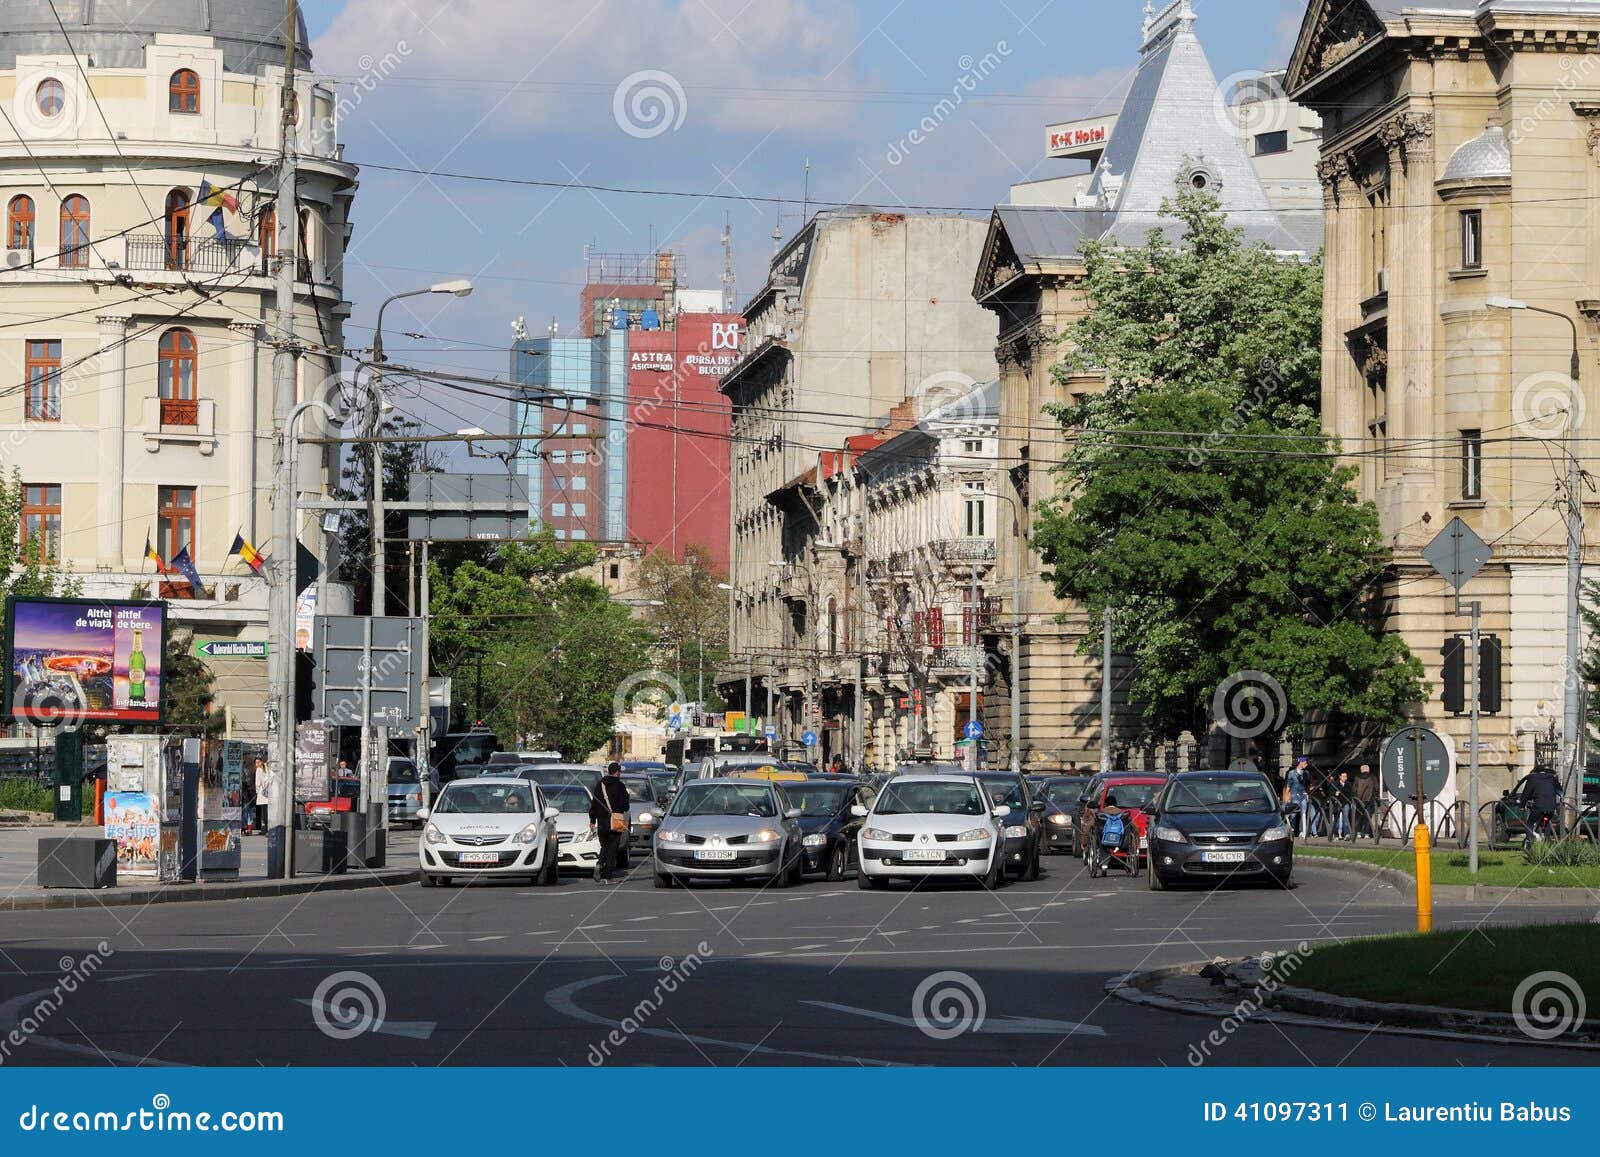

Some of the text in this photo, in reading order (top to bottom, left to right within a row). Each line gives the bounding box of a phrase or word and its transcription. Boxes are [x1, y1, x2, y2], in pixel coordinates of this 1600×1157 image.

[1051, 126, 1105, 148] K+K Hotel
[632, 353, 673, 362] ASTRA
[686, 355, 716, 365] BURSA
[718, 357, 730, 365] DE
[87, 609, 112, 618] Altfel
[117, 610, 141, 619] altfel
[75, 618, 87, 627] de
[117, 621, 152, 629] de bere.
[1397, 747, 1405, 789] VESTA
